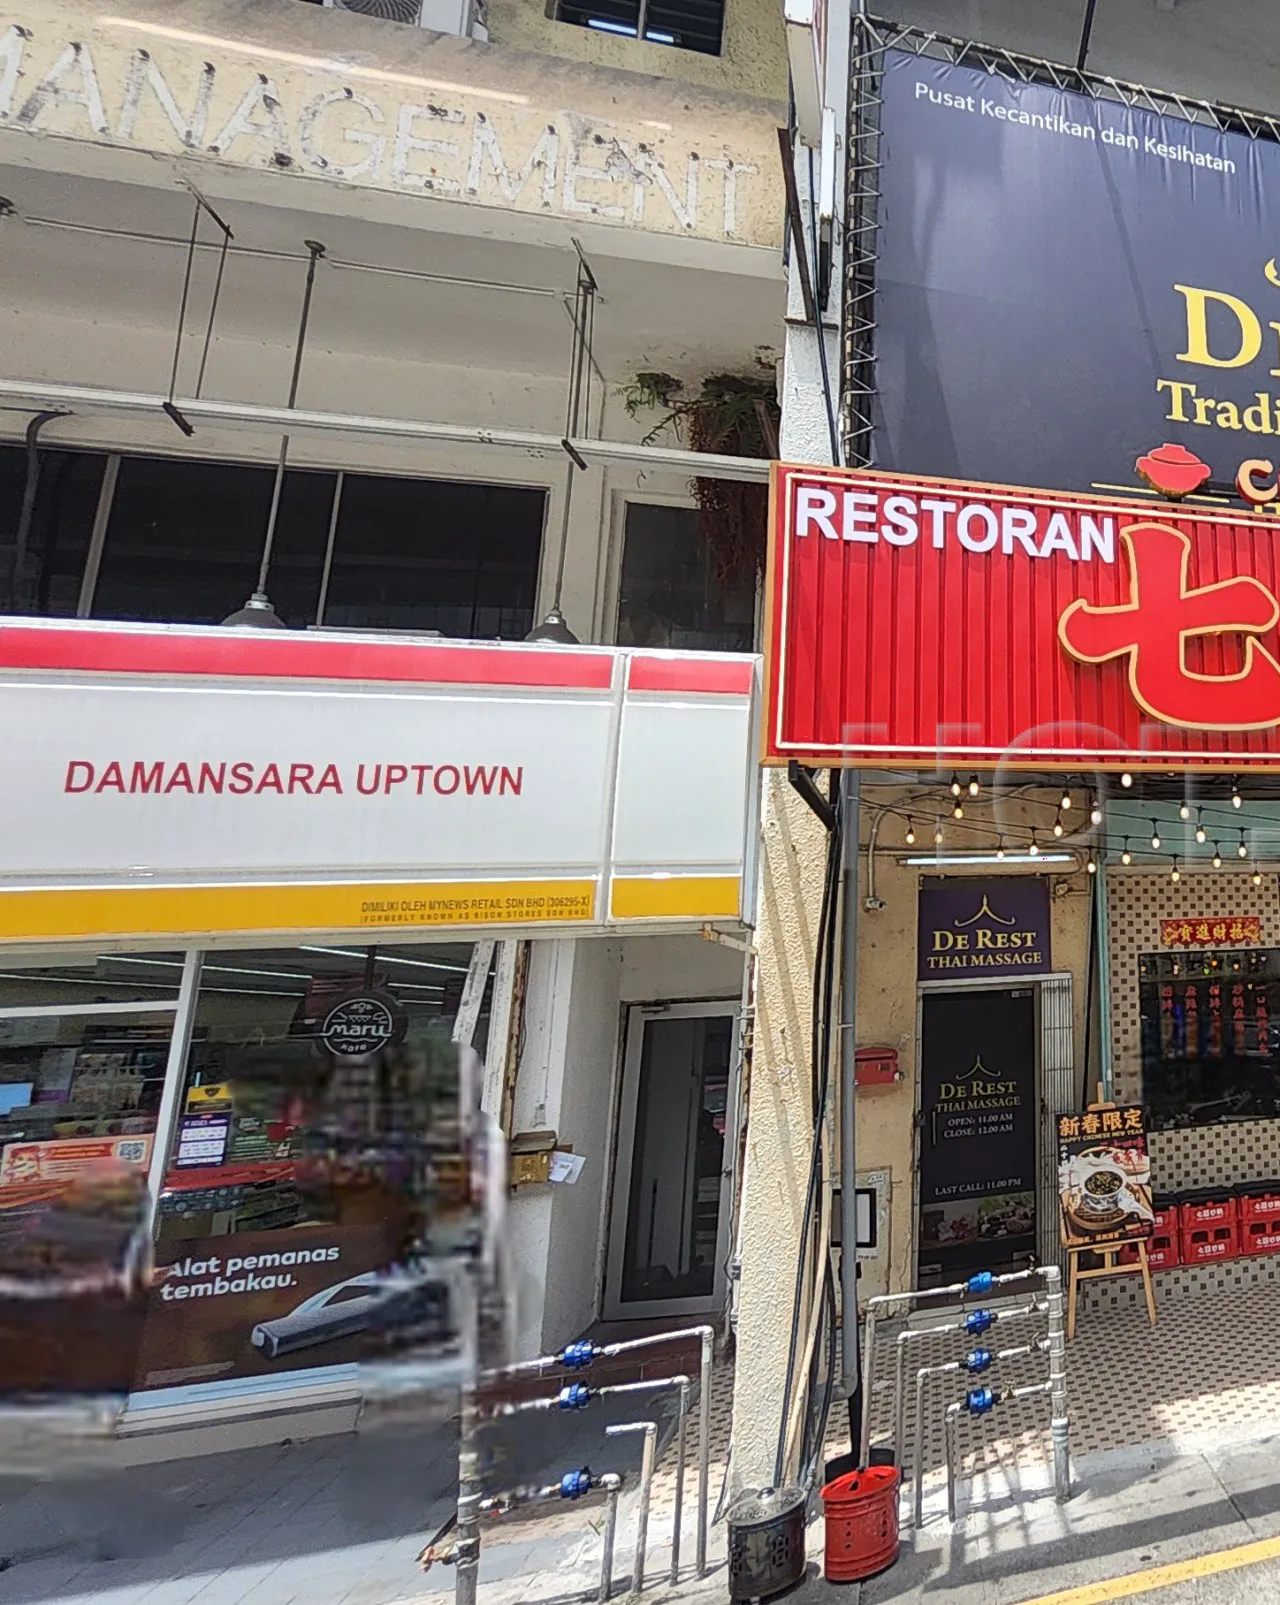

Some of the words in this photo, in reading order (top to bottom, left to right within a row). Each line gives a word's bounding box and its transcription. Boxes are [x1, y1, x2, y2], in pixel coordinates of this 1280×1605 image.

[0, 24, 760, 236] ANAGEMENT
[914, 82, 974, 112] Pusat
[981, 99, 1096, 141] Kecantikan
[1101, 127, 1139, 150] dan
[1144, 136, 1236, 175] Kesihatan
[795, 487, 1116, 563] RESTORAN
[64, 760, 343, 795] DAMANSARA
[355, 764, 525, 796] UPTOWN
[401, 901, 427, 911] OLEH
[429, 900, 469, 911] MYNEWS
[471, 899, 502, 909] RETAIL
[505, 898, 524, 908] SDN
[526, 898, 545, 908] BHD
[932, 930, 970, 951] DE
[975, 929, 1036, 949] REST
[927, 955, 968, 969] THAI
[970, 952, 1042, 967] MASSAGE
[939, 1083, 967, 1100] DE
[971, 1080, 1017, 1097] REST
[935, 1102, 966, 1113] THAI
[967, 1096, 1021, 1110] MASSAGE
[943, 1127, 976, 1138] CLOSE:
[999, 1123, 1013, 1132] AM
[947, 1116, 976, 1127] OPEN:
[1000, 1113, 1013, 1121] AM
[1059, 1108, 1143, 1137] 新春限定
[934, 1185, 958, 1196] LAST
[958, 1182, 985, 1193] CALL:
[1008, 1177, 1021, 1187] PM
[167, 1257, 221, 1279] Alat
[226, 1245, 341, 1277] pemanas
[161, 1270, 298, 1302] tembakau.
